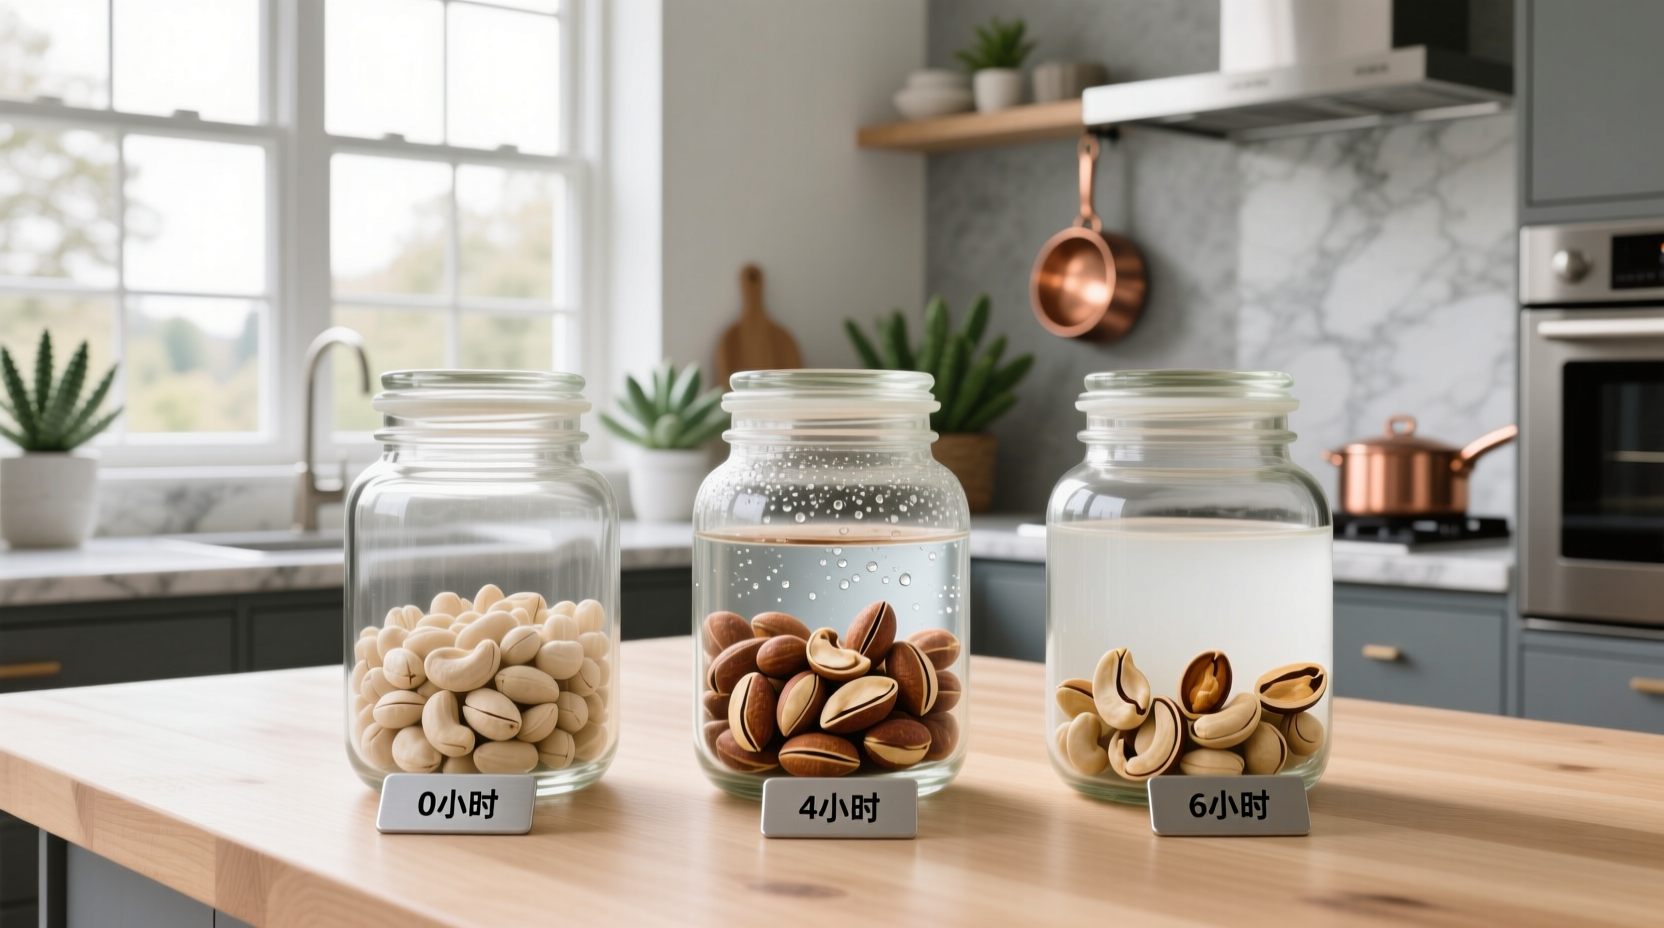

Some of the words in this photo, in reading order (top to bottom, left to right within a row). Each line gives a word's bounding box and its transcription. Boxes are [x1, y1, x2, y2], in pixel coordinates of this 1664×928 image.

[417, 788, 498, 820] 0小时
[798, 791, 880, 823] 4小时
[1188, 789, 1270, 820] 6小时
